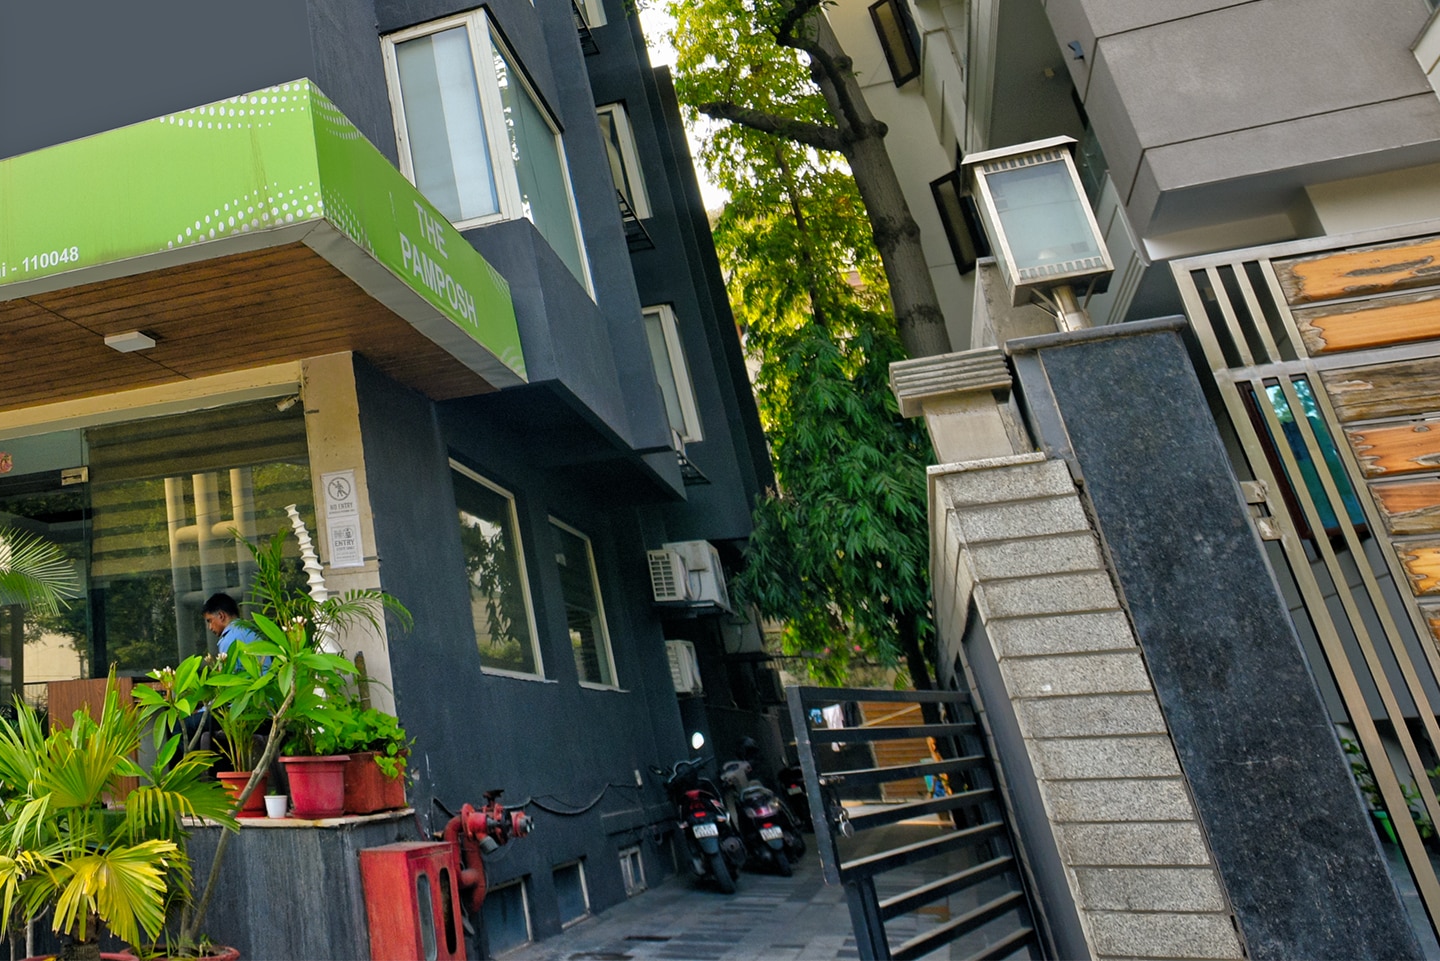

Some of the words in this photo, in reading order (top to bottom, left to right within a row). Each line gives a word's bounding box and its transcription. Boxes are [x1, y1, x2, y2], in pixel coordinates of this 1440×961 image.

[413, 200, 448, 260] THE
[22, 246, 79, 272] 110048
[400, 231, 478, 328] PAMPOSH
[335, 539, 355, 547] ENTRY
